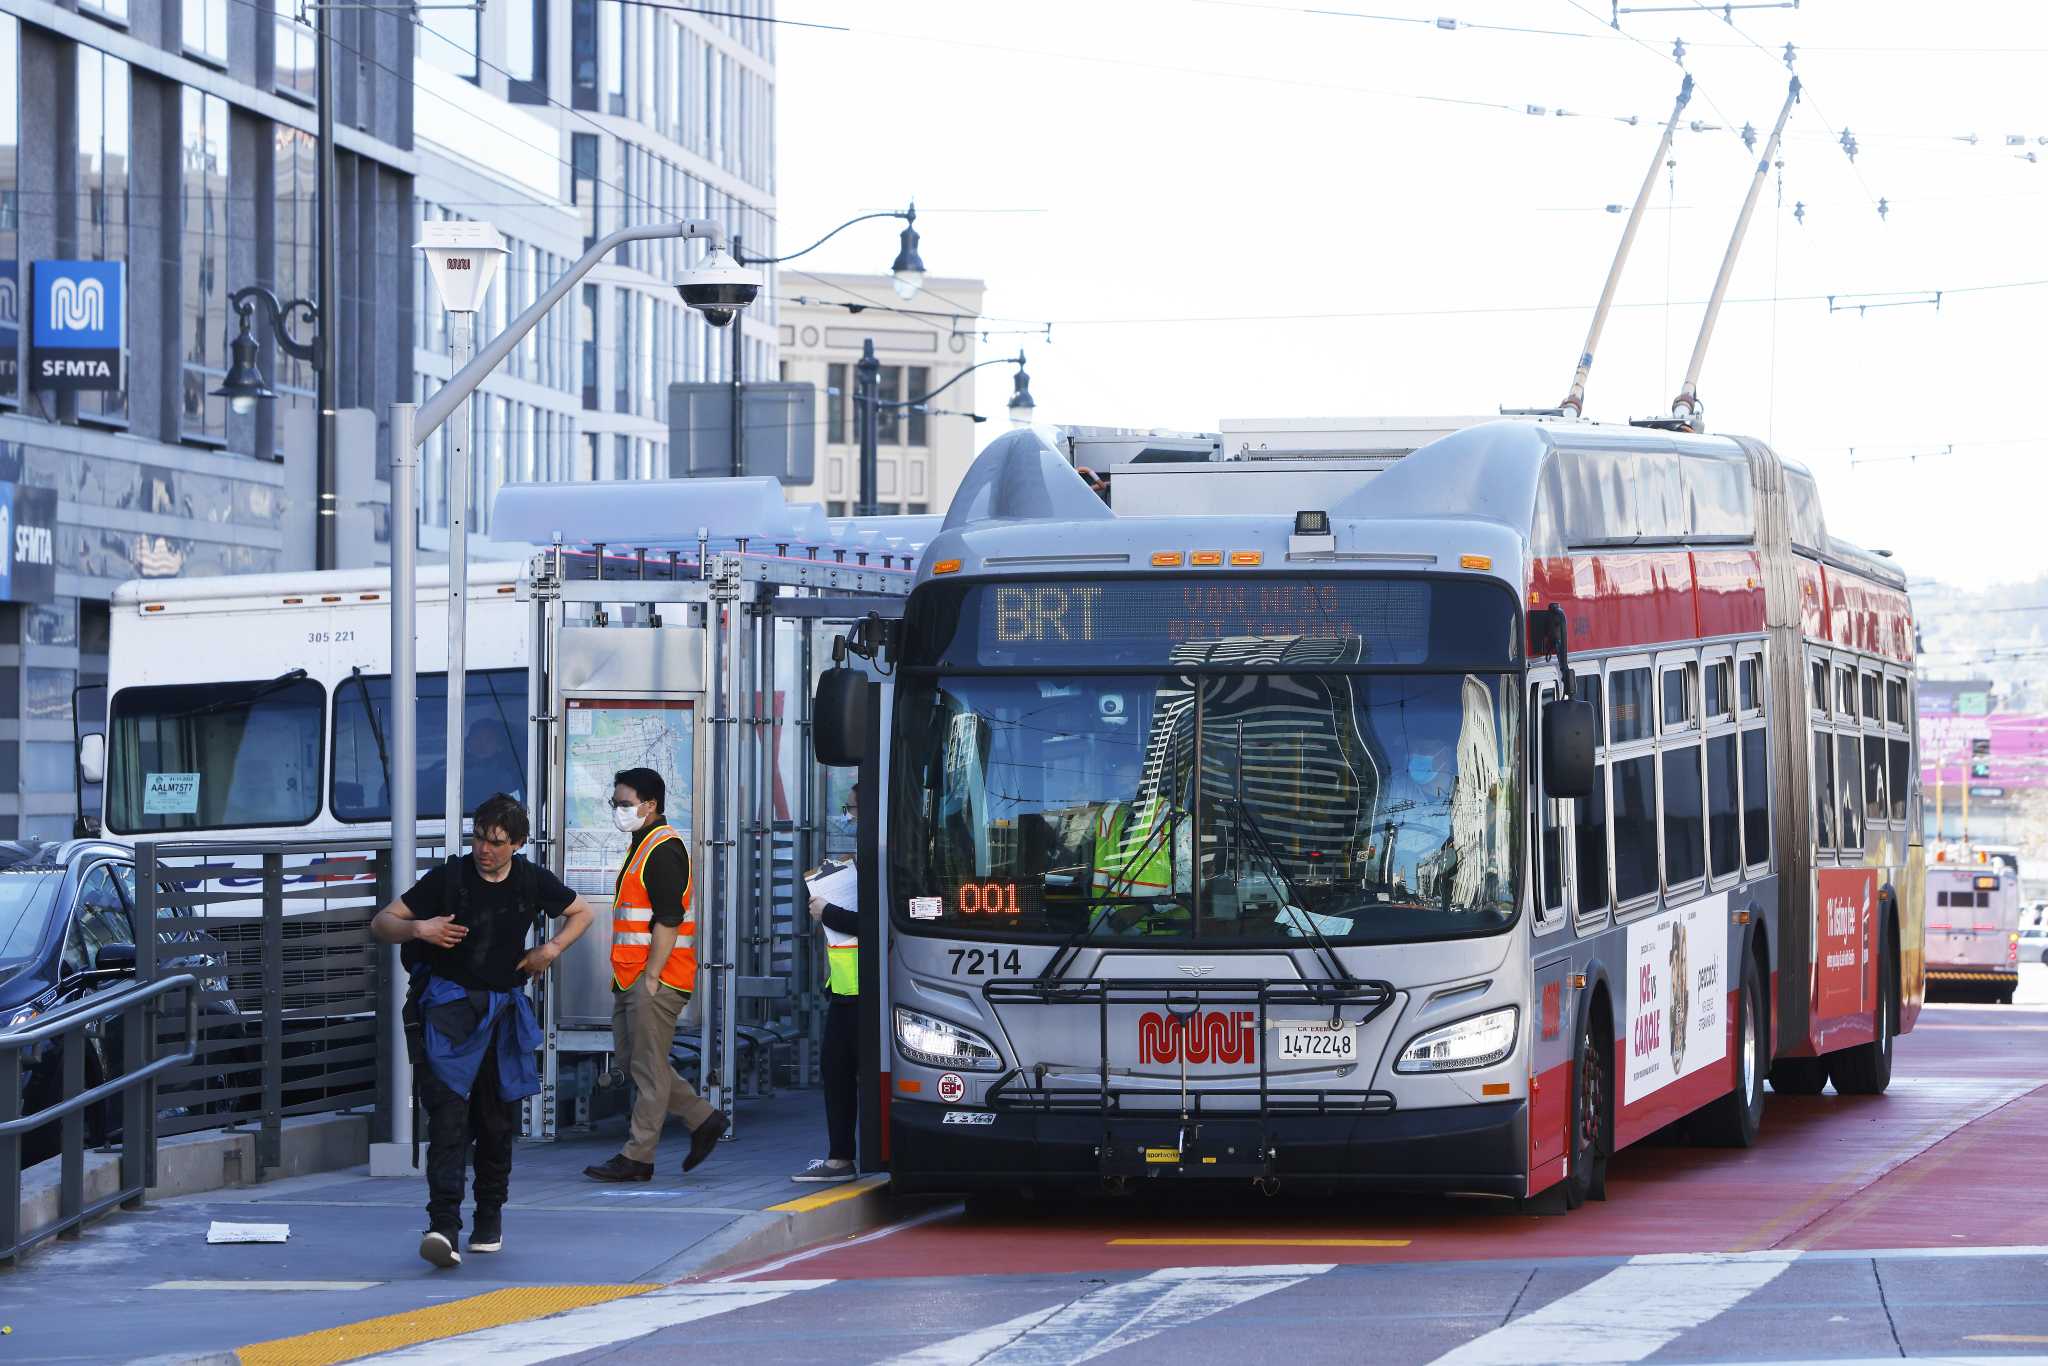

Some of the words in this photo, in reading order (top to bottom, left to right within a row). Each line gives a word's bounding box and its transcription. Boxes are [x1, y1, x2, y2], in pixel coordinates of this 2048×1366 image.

[42, 360, 111, 377] SFMTA
[15, 524, 53, 566] SFMTA
[997, 587, 1102, 641] BRT
[1183, 586, 1247, 614] VAN
[1260, 586, 1339, 613] NESS
[308, 632, 330, 643] 305
[335, 631, 354, 642] 221
[959, 883, 1020, 913] 001
[948, 949, 1022, 976] 7214
[1283, 1035, 1351, 1054] 1472248
[1634, 1009, 1661, 1058] CAROLE
